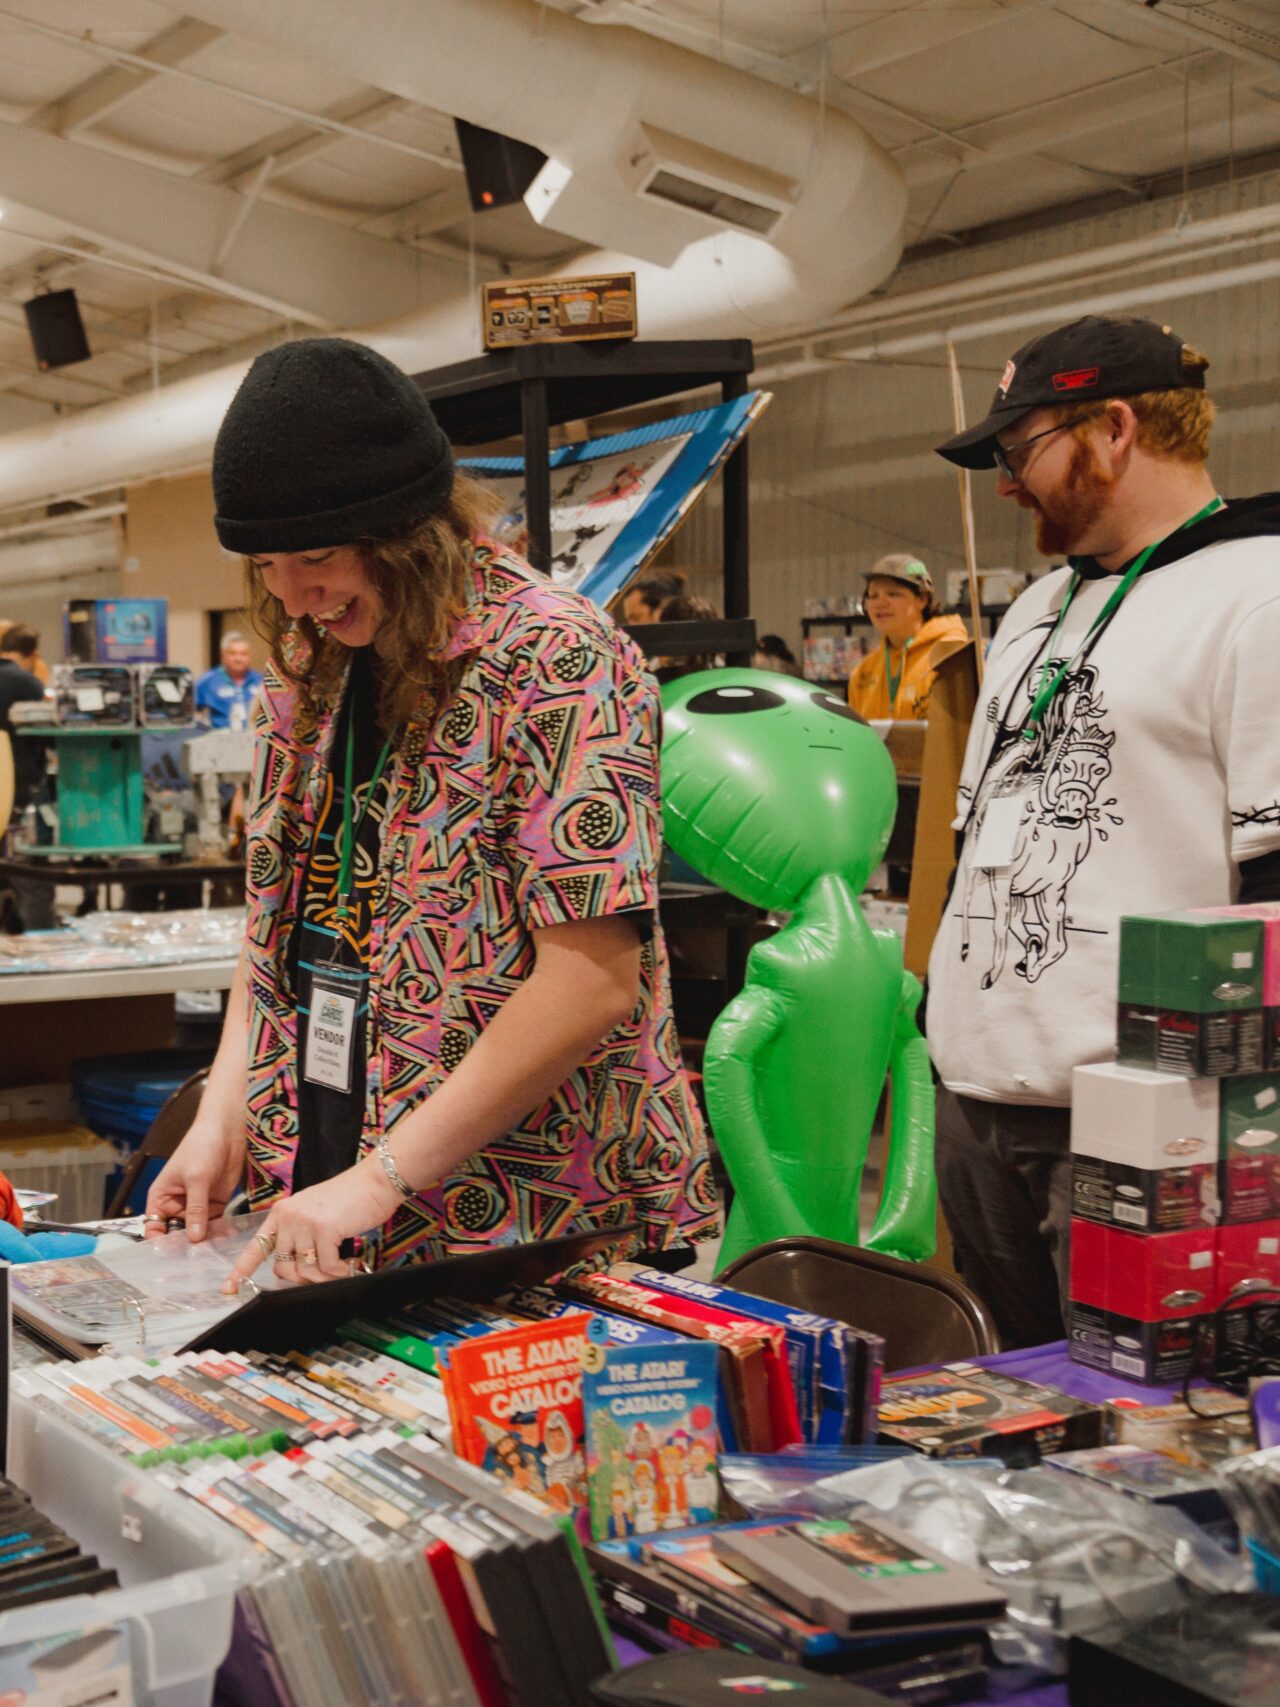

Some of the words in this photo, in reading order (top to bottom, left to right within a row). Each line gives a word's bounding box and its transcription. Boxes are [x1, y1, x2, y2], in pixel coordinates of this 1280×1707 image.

[314, 1026, 345, 1047] VENDOR
[638, 1269, 722, 1299] BOWLING
[591, 1319, 603, 1335] 3
[481, 1347, 524, 1377] THE
[586, 1346, 599, 1365] 3
[469, 1380, 506, 1396] VIDEO
[507, 1364, 566, 1389] COMPUTER
[607, 1364, 638, 1382] THE
[640, 1361, 687, 1379] ATARI
[611, 1393, 687, 1416] CATALOG
